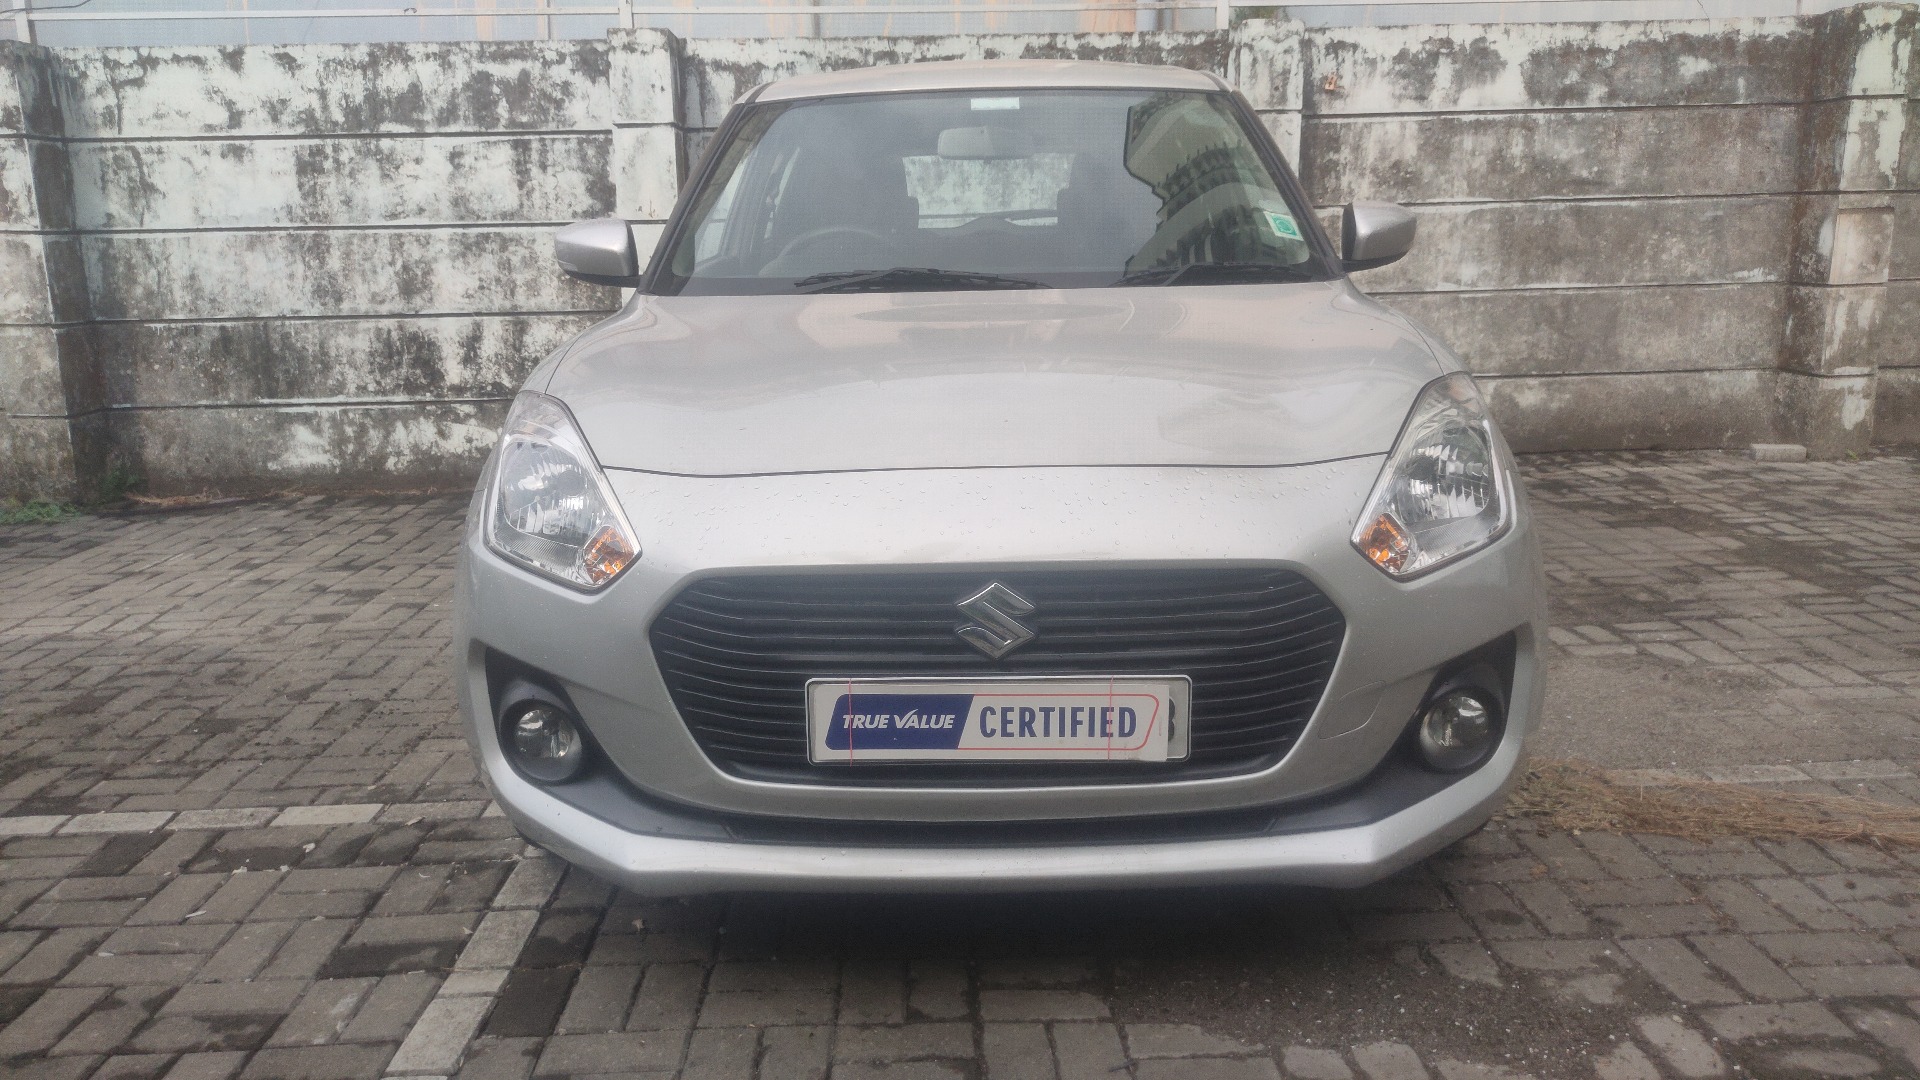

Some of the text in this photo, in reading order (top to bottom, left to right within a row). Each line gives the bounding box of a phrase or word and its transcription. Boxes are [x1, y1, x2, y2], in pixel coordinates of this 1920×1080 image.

[842, 705, 1137, 738] TRUE VALUE CERTIFIED
